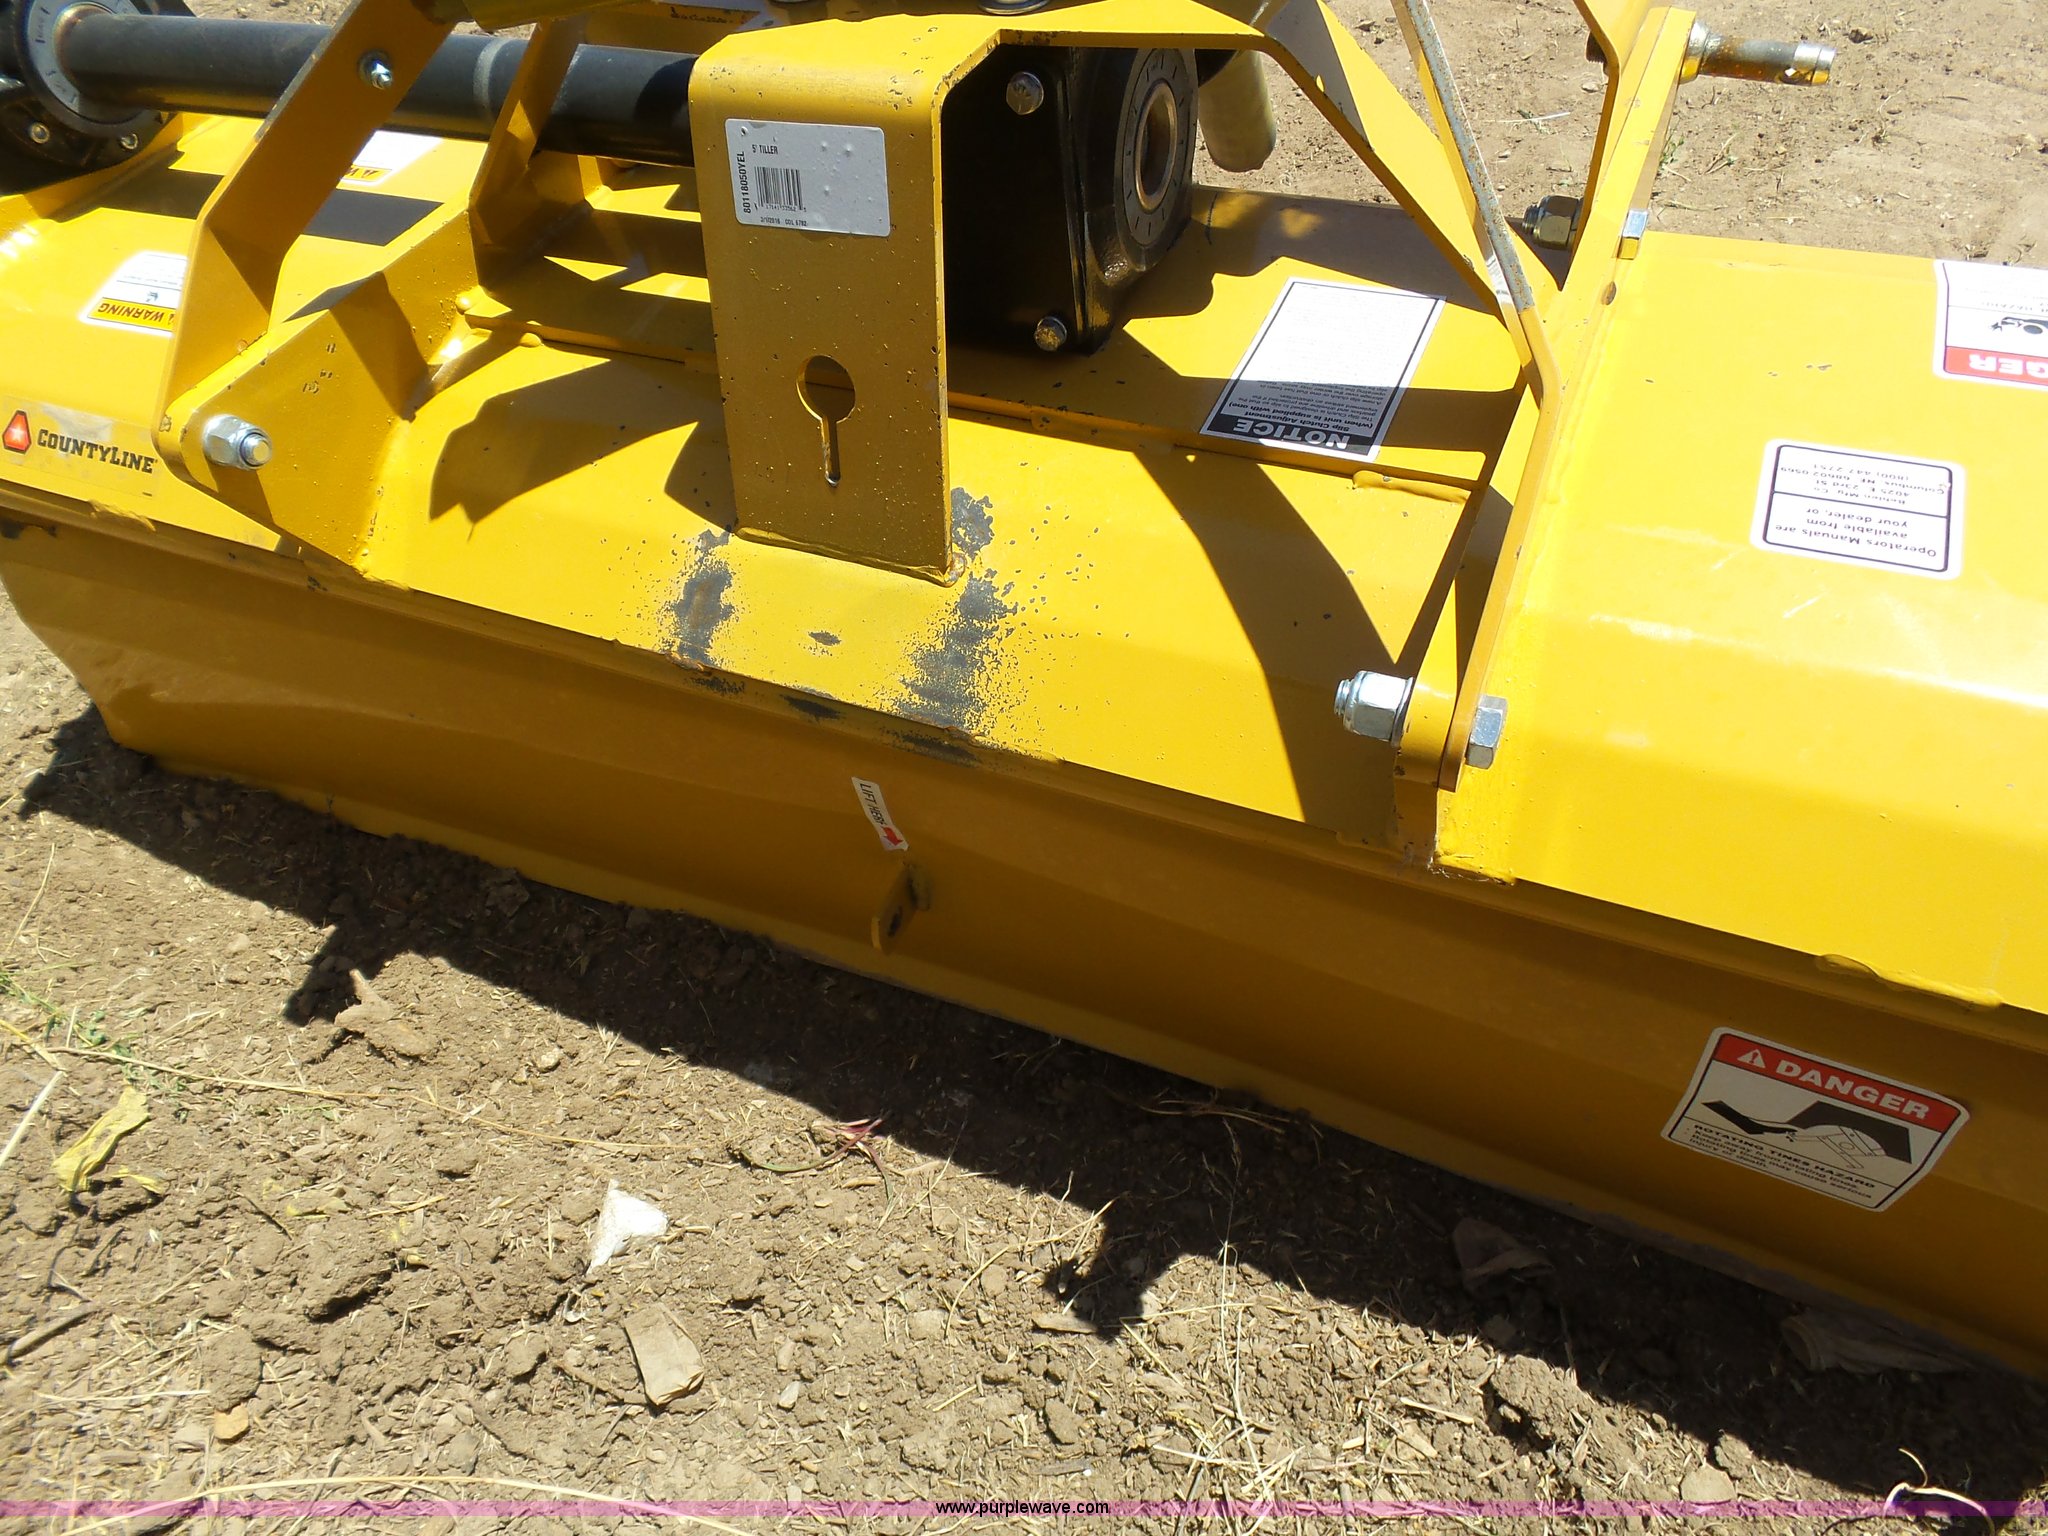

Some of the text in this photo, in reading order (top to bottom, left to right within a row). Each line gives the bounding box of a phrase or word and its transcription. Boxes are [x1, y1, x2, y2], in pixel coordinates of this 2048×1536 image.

[759, 144, 779, 155] TILLER
[736, 151, 751, 214] 80118050YEL
[98, 302, 165, 322] WARNING
[1227, 401, 1249, 409] one)
[1249, 405, 1270, 413] with
[1271, 408, 1311, 419] supplied
[1243, 410, 1298, 423] Adjustment
[1298, 419, 1330, 428] Clutch
[1323, 416, 1342, 424] unit
[1343, 419, 1373, 429] (when
[1231, 417, 1351, 449] NOTICE
[1806, 507, 1907, 528] your dealer, or
[1805, 518, 1907, 539] available from
[1775, 524, 1936, 557] Operators Manuals are
[860, 783, 877, 805] LIFT
[1772, 1059, 1934, 1119] DANGER
[1693, 1124, 1876, 1188] ROTATING TINES HAZARD
